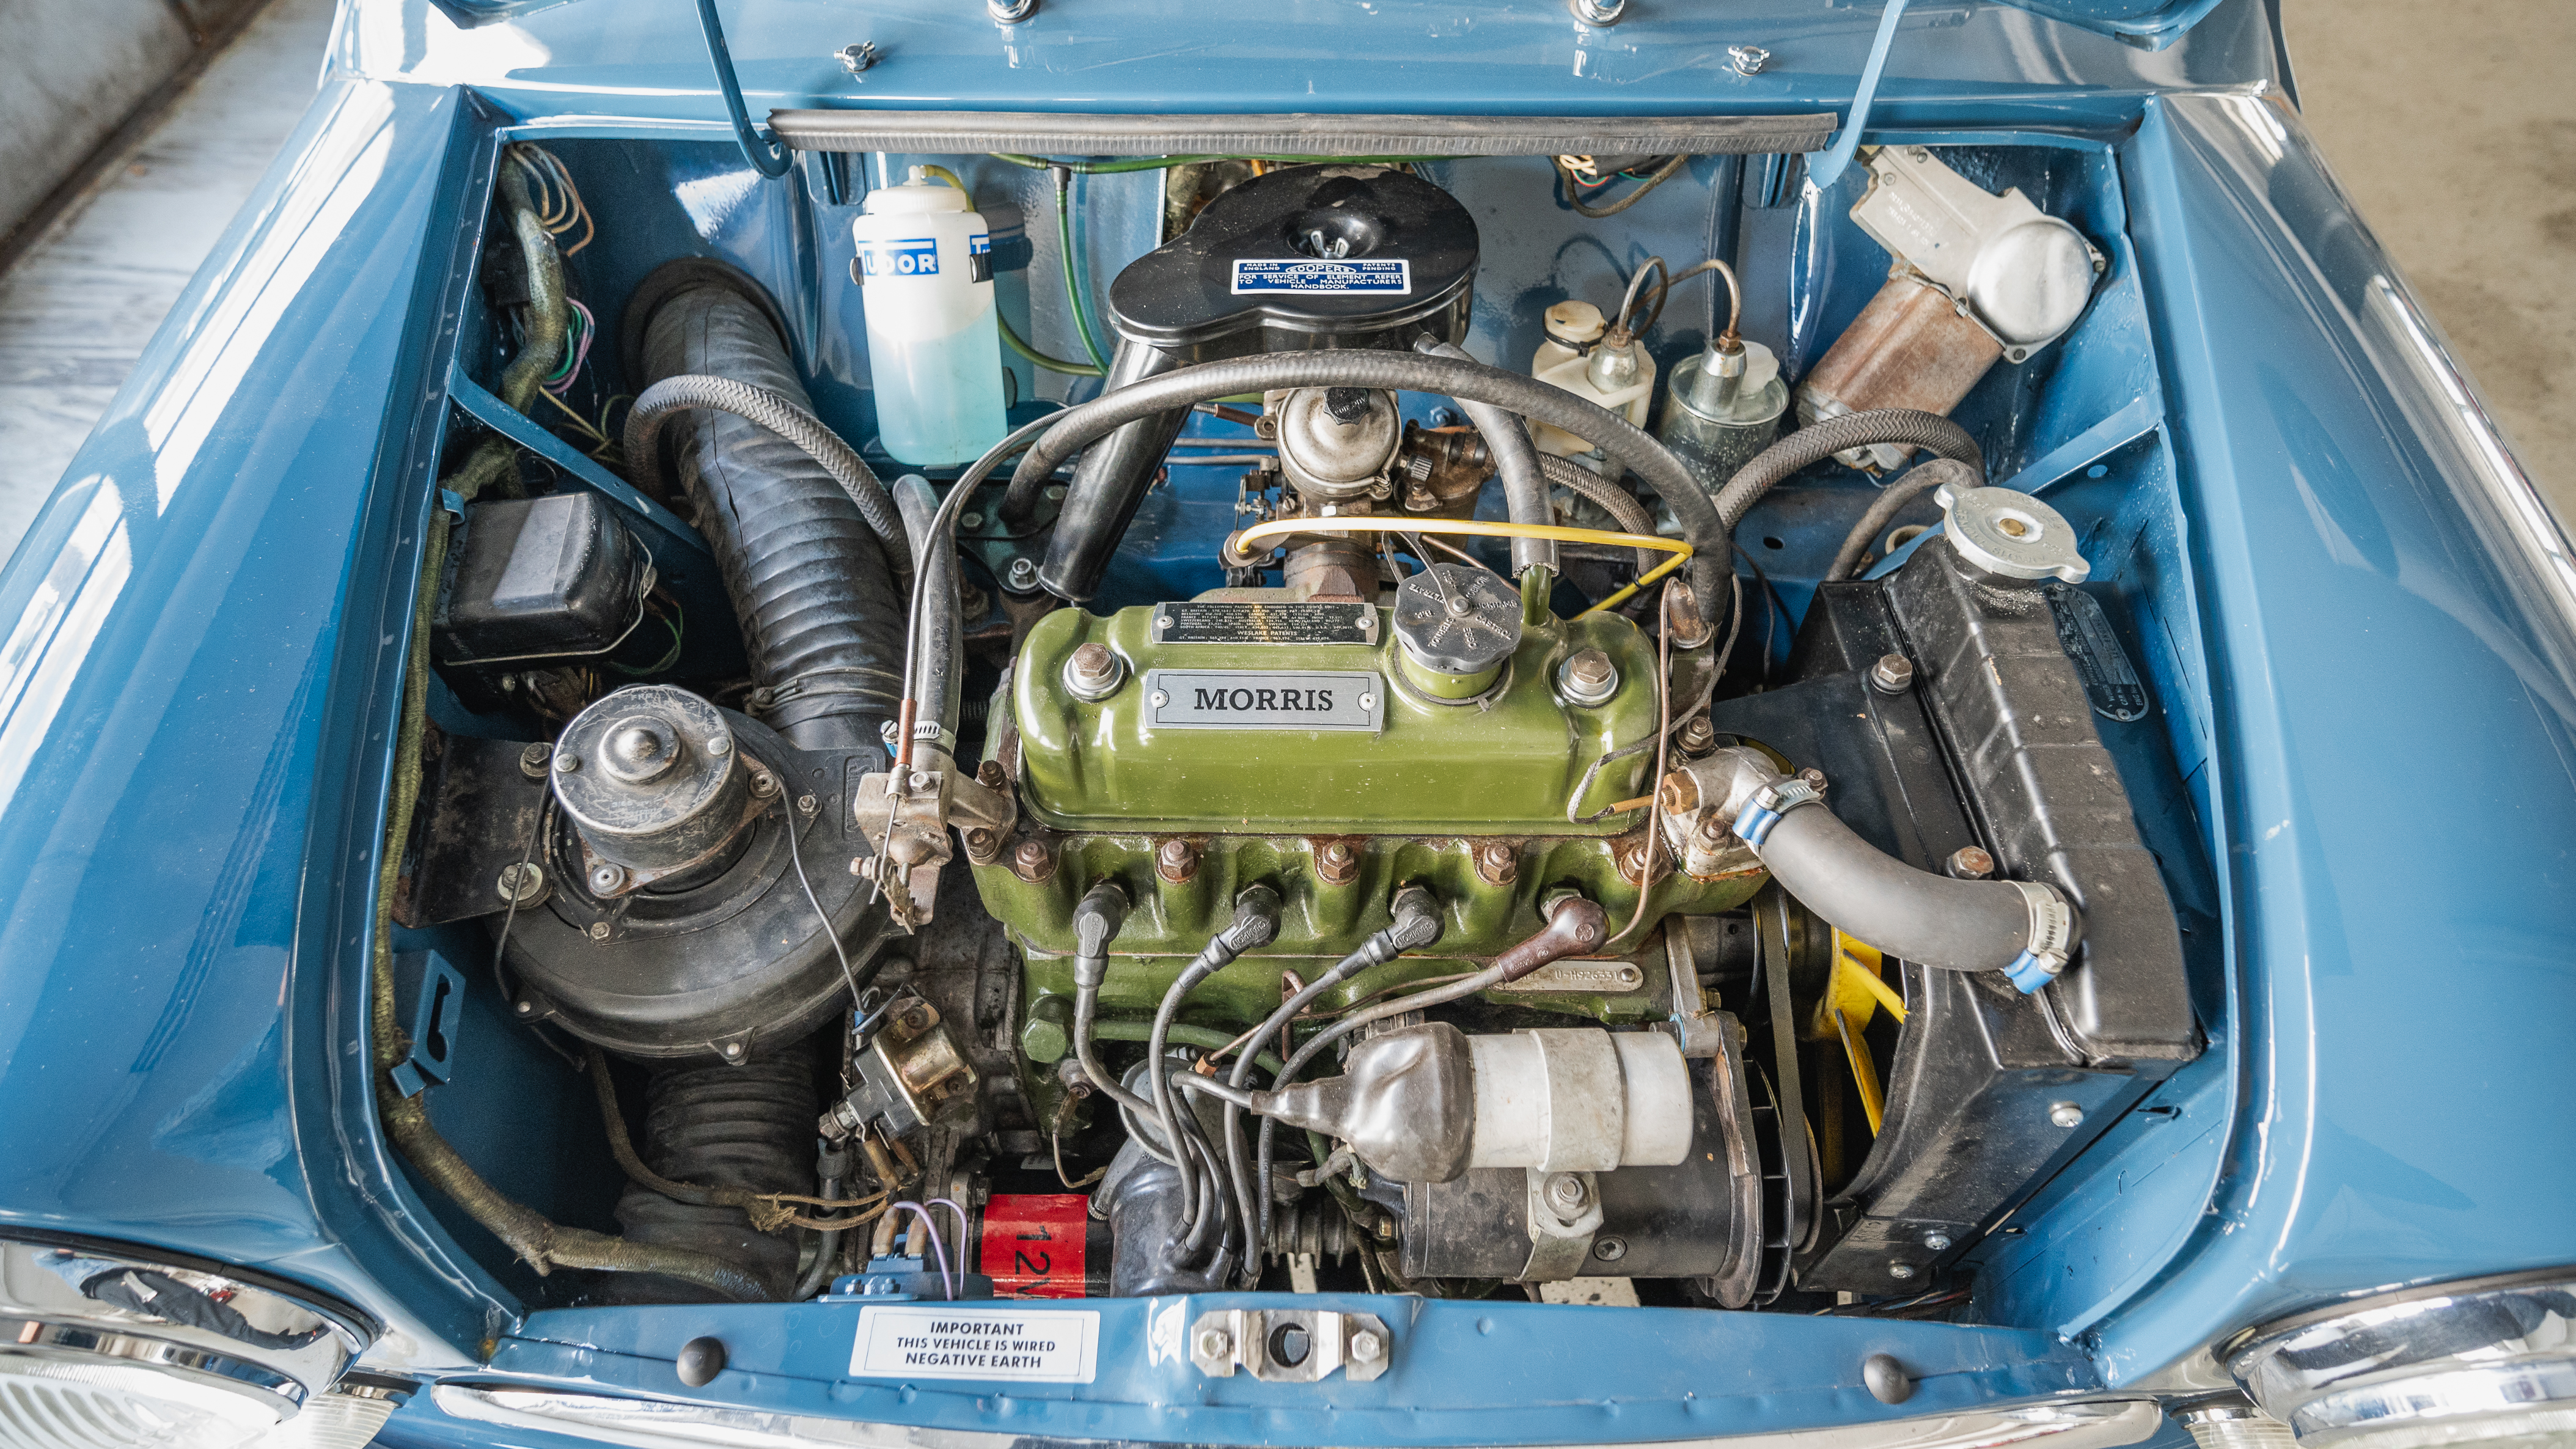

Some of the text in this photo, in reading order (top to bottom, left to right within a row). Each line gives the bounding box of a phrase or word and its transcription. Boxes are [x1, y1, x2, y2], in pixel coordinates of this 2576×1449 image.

[1462, 627, 1478, 650] ESSO
[1475, 615, 1513, 640] CASTROL
[1194, 688, 1334, 711] MORRIS
[1088, 916, 1099, 953] CHAMPION
[1232, 921, 1266, 948] CHAMPION
[1396, 922, 1433, 946] CHAMPION
[1282, 1057, 1300, 1080] RIPAULTS
[930, 1321, 1024, 1335] IMPORTANT
[897, 1337, 1056, 1352] THIS VEHICLE IS WIRED
[905, 1352, 1041, 1368] NEGATIVE EARTH
